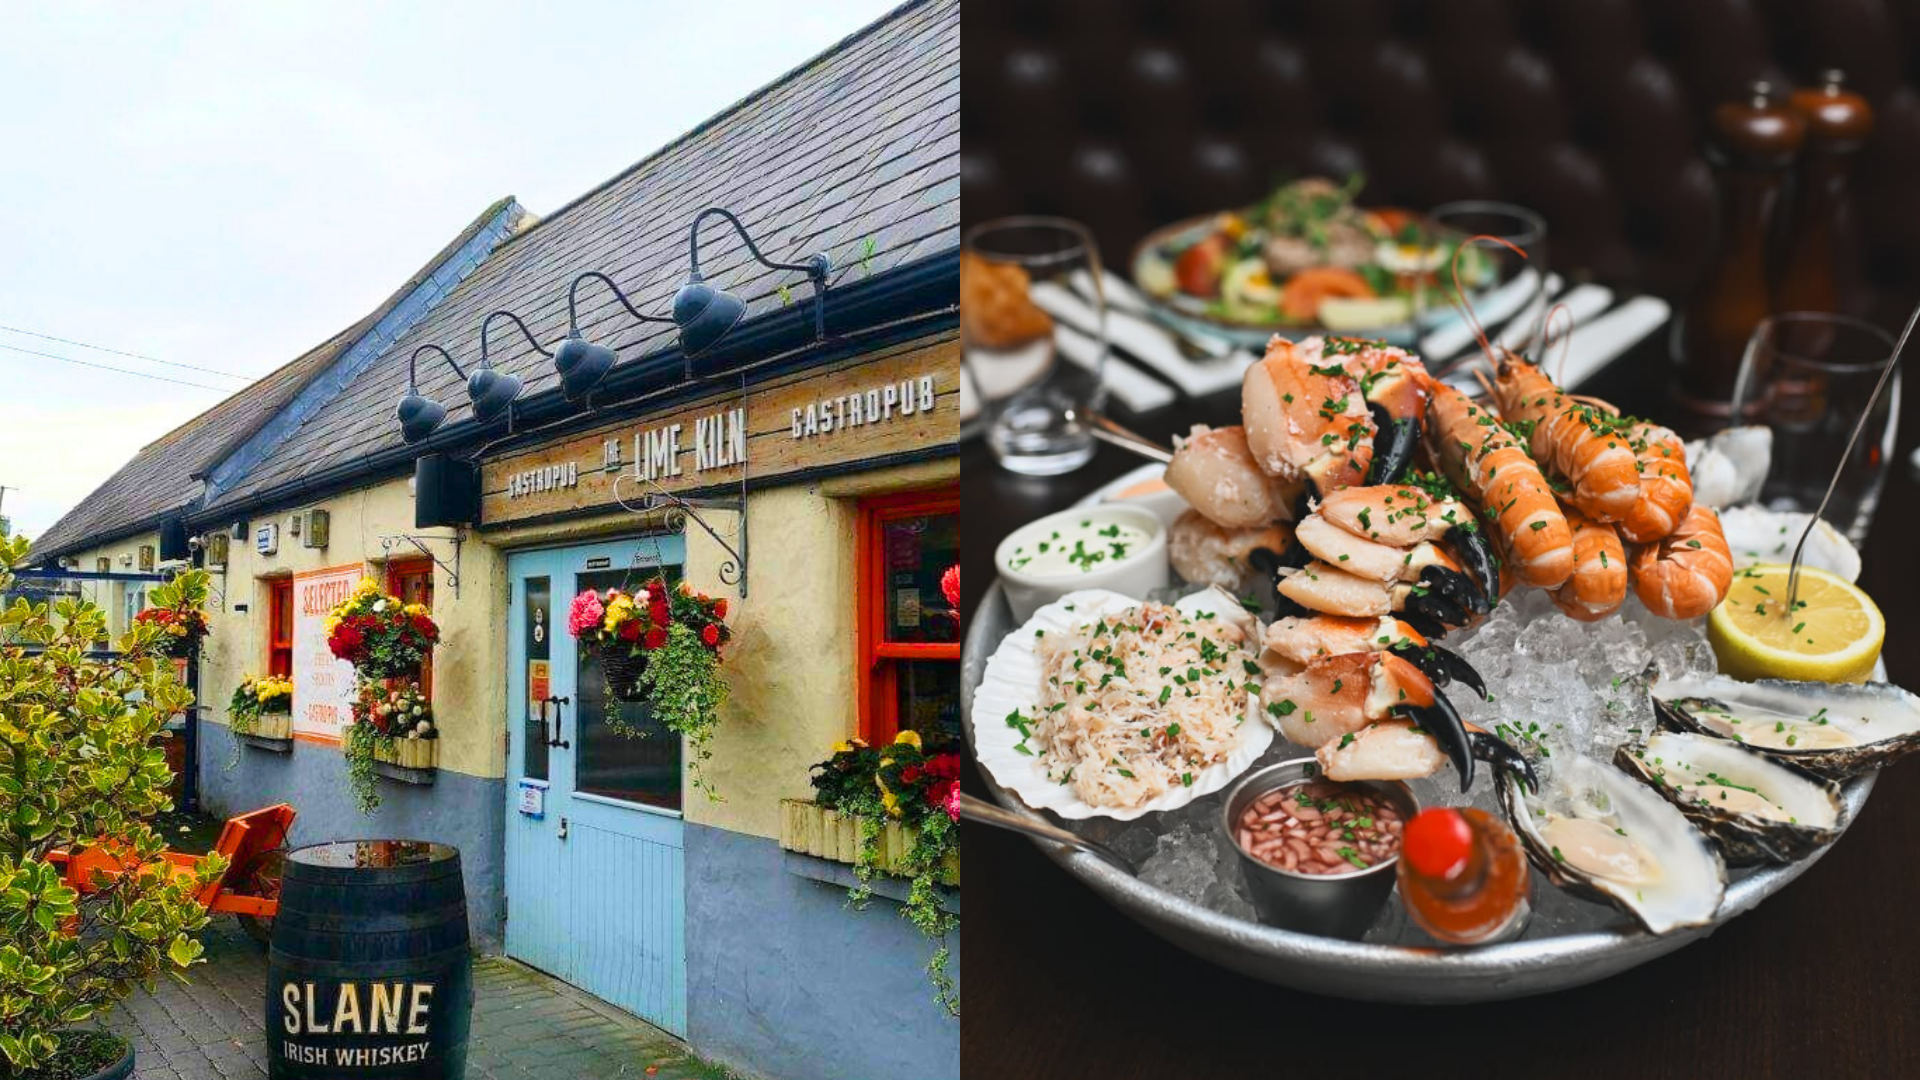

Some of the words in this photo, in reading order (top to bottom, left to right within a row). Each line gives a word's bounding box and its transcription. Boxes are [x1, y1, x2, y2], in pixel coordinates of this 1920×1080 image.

[791, 375, 936, 439] GASTROPUB
[602, 438, 621, 465] THE
[634, 423, 684, 483] LIME
[695, 407, 746, 472] KILN
[508, 460, 578, 498] GASTROPUB
[303, 579, 351, 616] SELECTED
[282, 982, 435, 1035] SLANE
[283, 1041, 327, 1067] IRISH
[335, 1041, 431, 1068] WHISKEY
